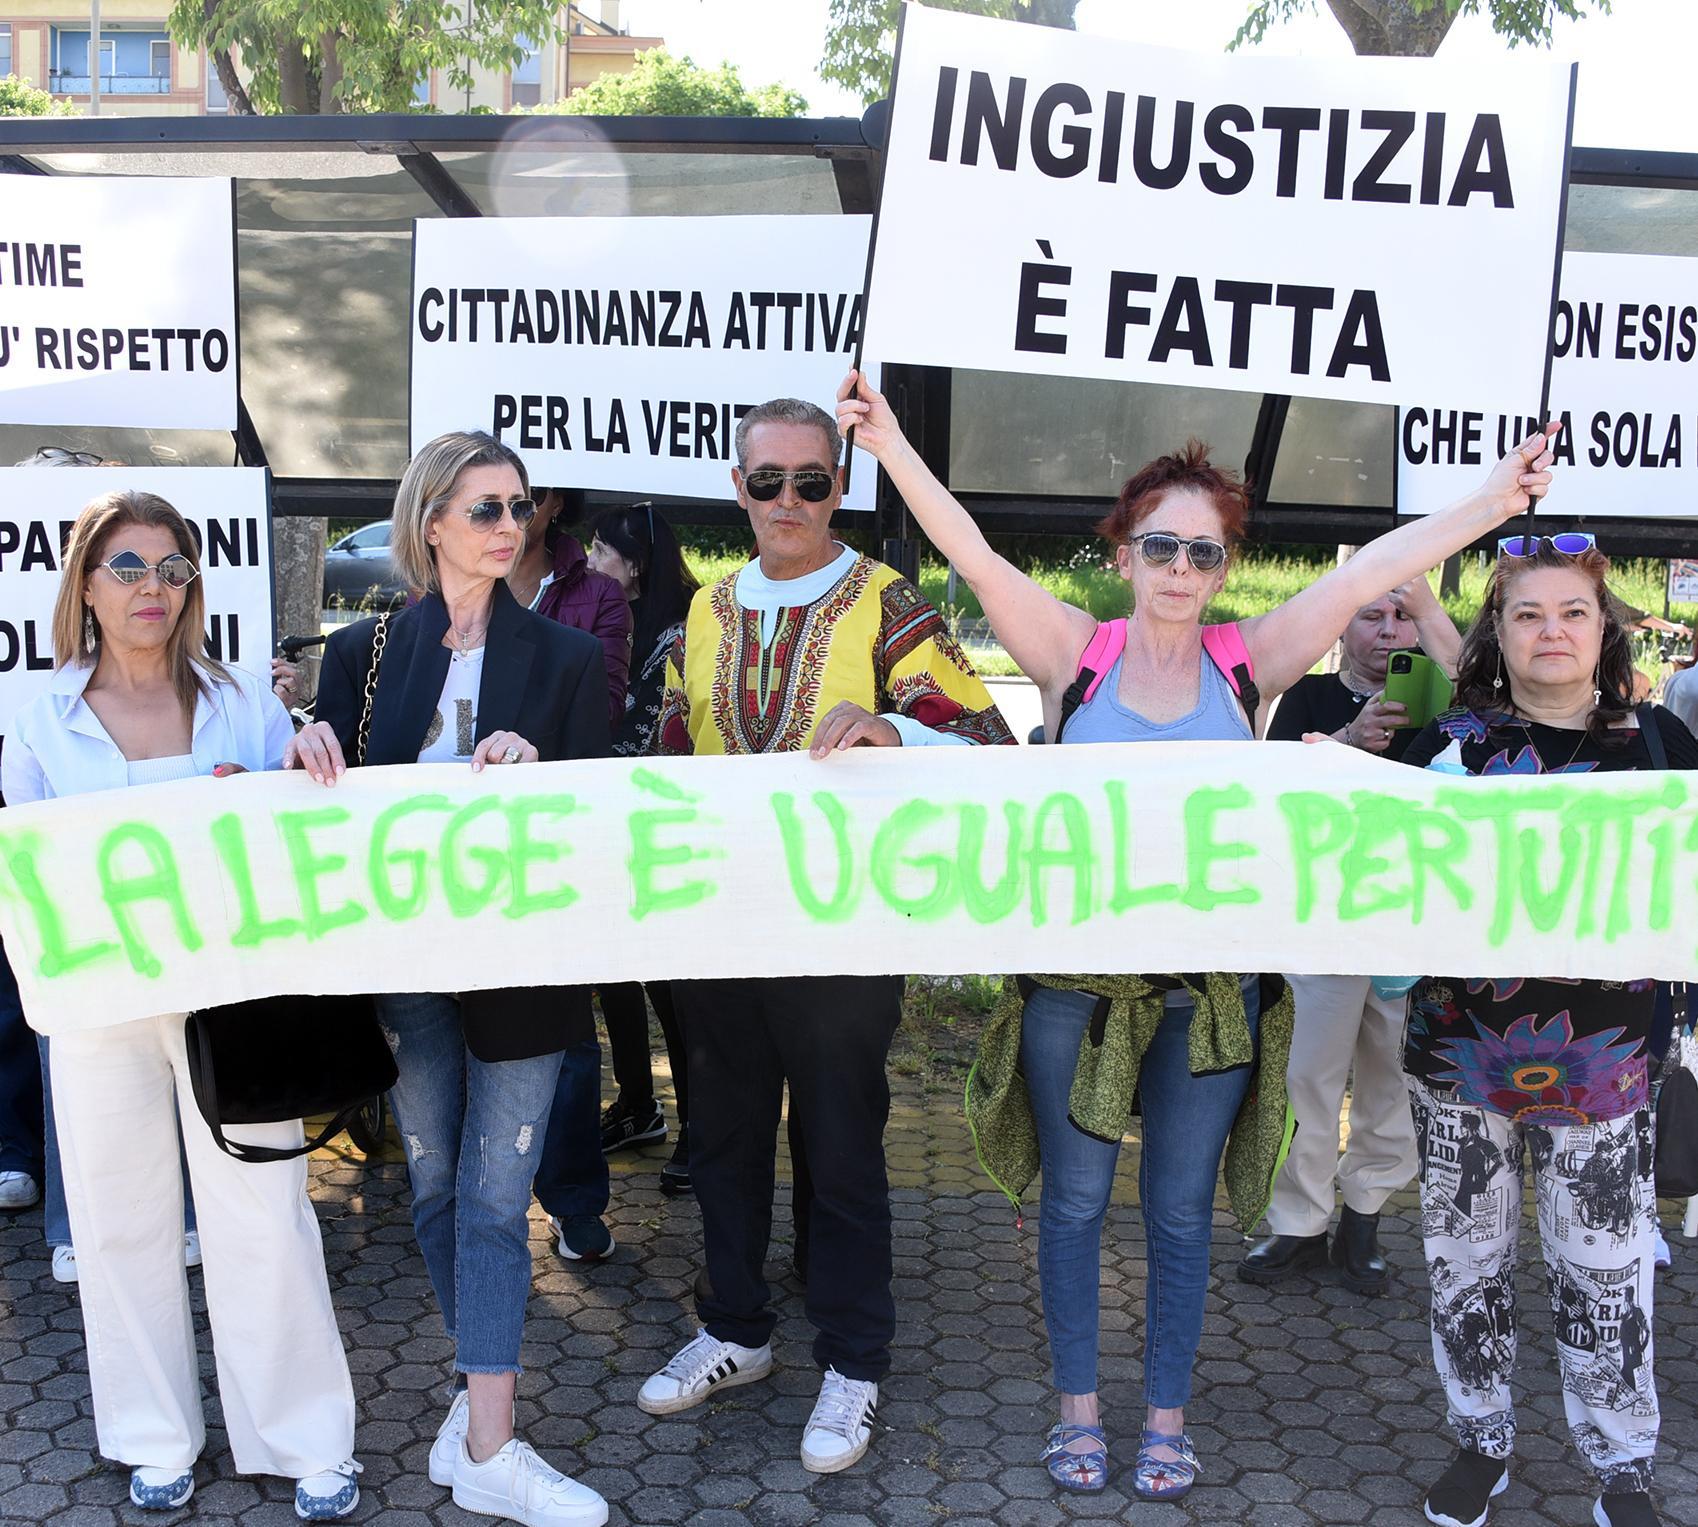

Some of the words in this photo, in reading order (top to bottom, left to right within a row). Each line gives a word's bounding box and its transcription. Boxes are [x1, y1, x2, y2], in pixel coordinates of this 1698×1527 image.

[929, 66, 1515, 209] INGIUSTIZIA
[419, 287, 711, 349] CITTADINANZA
[1014, 239, 1072, 355] È
[1104, 270, 1392, 383] FATTA
[1615, 303, 1698, 363] ESIS
[35, 328, 229, 373] RISPETTO
[493, 394, 572, 451] PER
[584, 397, 631, 454] LA
[641, 399, 759, 461] VERI
[1403, 406, 1484, 465] CHE
[1588, 410, 1682, 468] SOLA
[8, 822, 204, 979] LA
[212, 794, 580, 948] LEGGE
[628, 768, 722, 921] È
[770, 780, 1262, 927] UGUALE
[1278, 790, 1474, 924] PER
